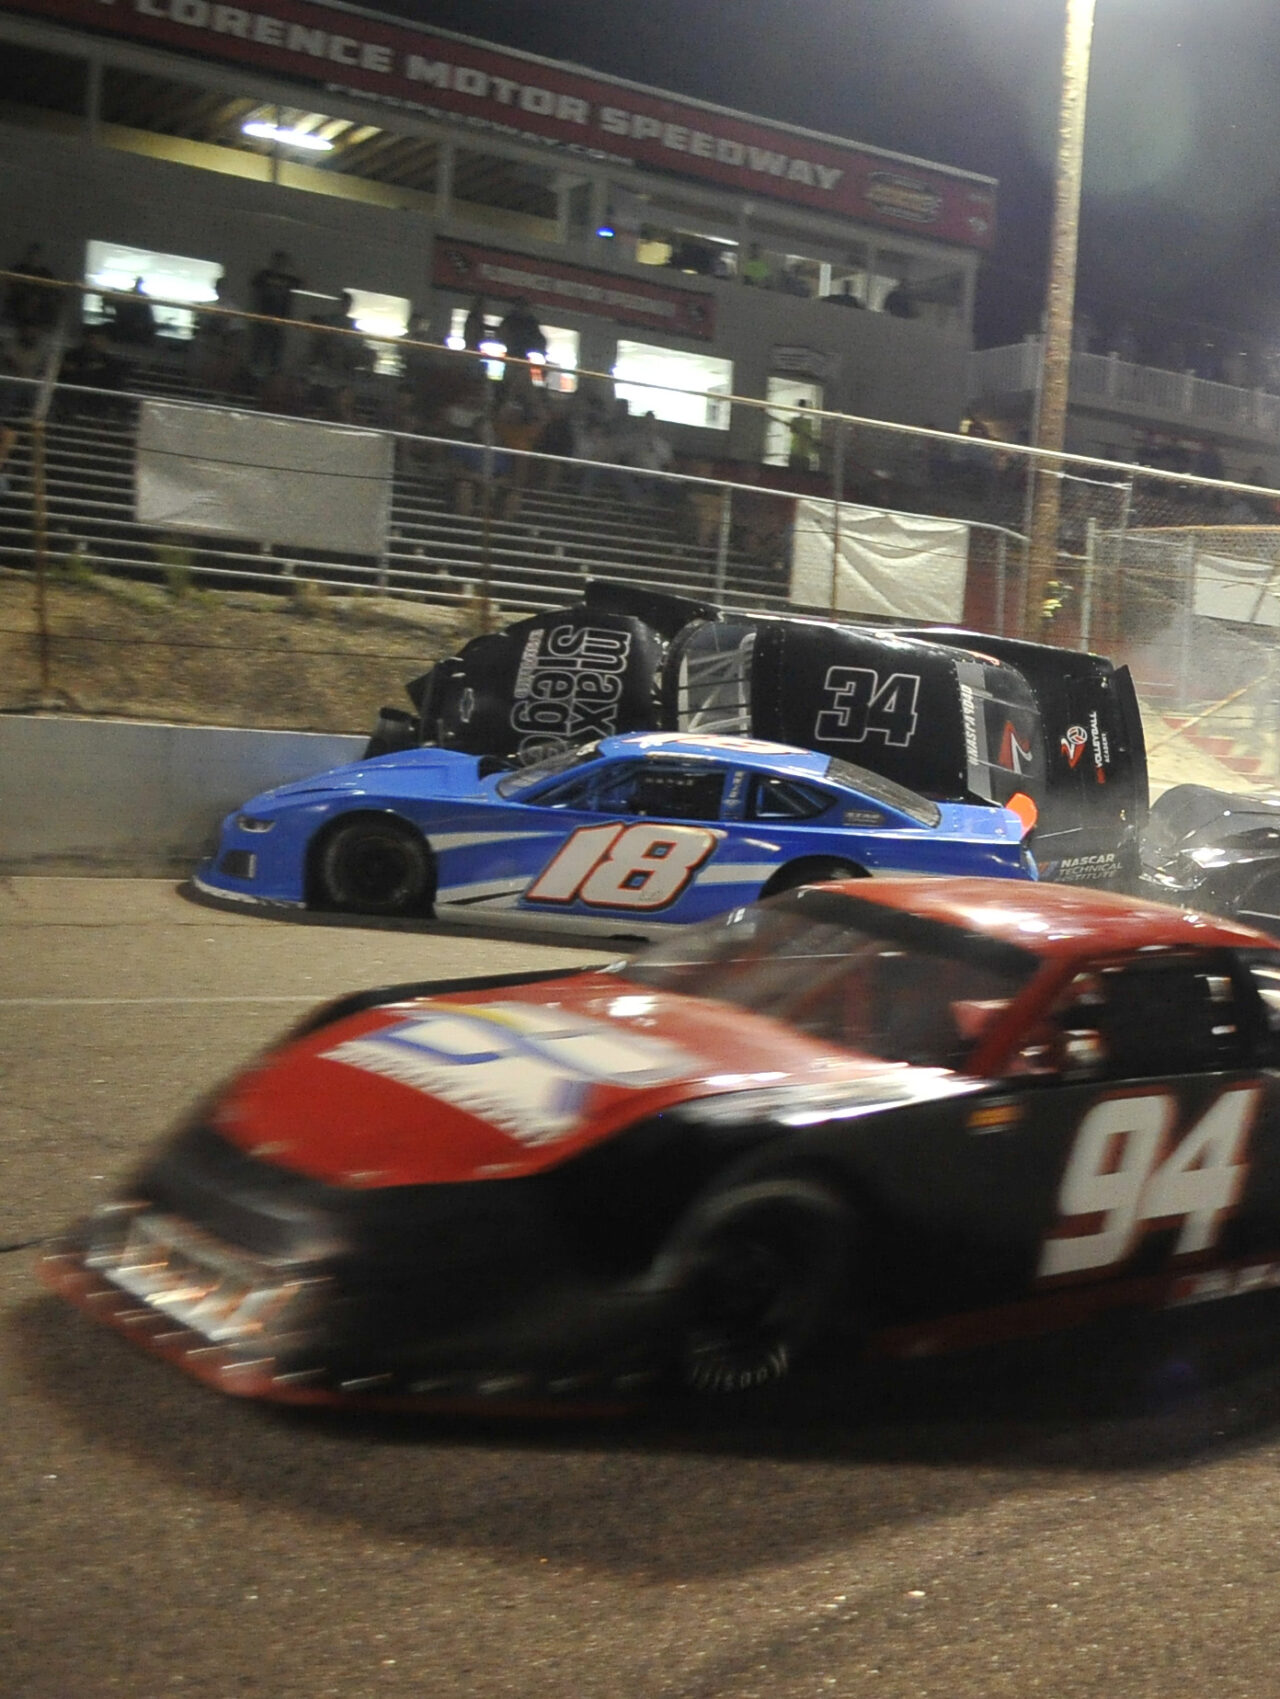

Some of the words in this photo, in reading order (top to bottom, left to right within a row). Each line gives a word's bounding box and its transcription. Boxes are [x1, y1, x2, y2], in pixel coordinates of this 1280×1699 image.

[104, 0, 396, 73] LORENCE
[407, 54, 589, 125] MOTOR
[600, 107, 844, 191] SPEEDWAY
[511, 625, 588, 768] Siege
[814, 665, 920, 748] 34
[1089, 711, 1103, 768] VOLLEYBALL
[524, 821, 719, 911] 18
[1061, 853, 1115, 868] NASCAR
[1036, 1084, 1262, 1280] 94
